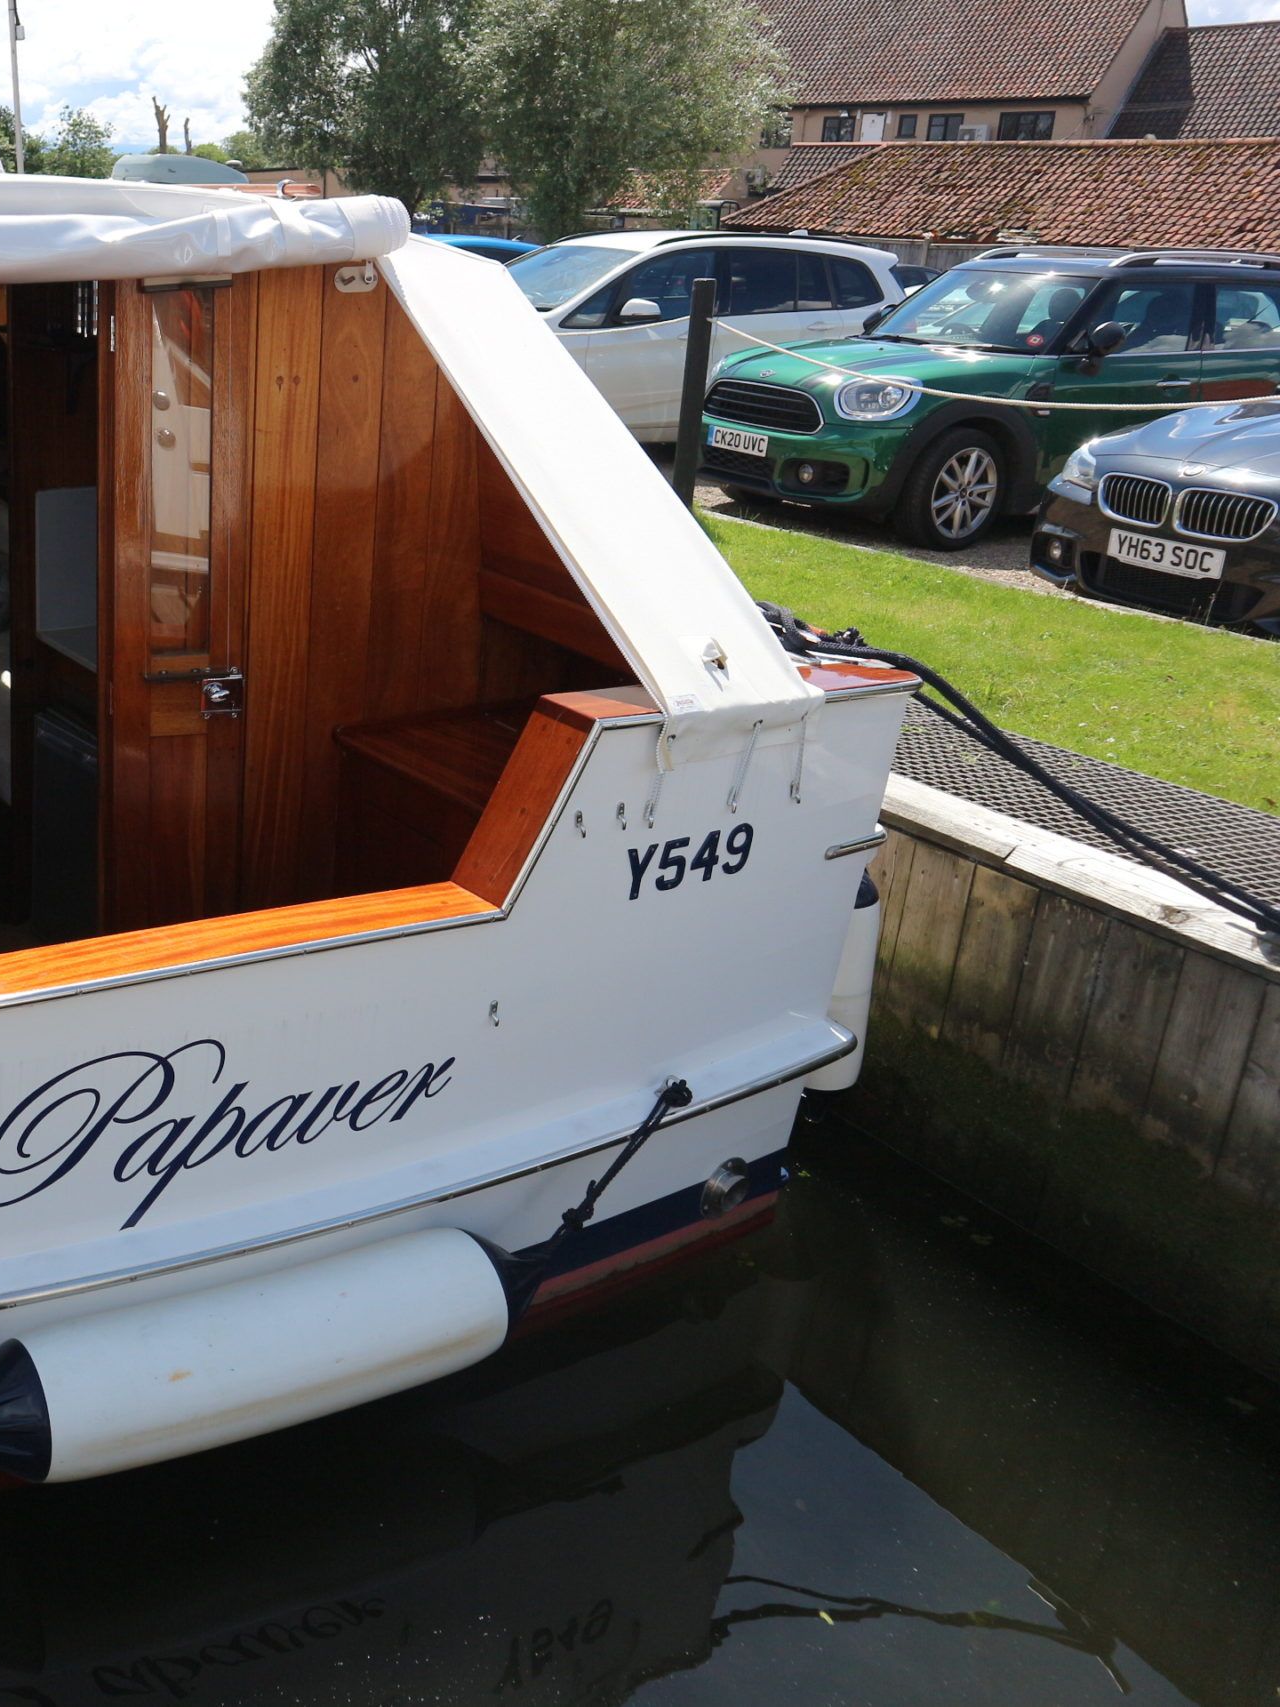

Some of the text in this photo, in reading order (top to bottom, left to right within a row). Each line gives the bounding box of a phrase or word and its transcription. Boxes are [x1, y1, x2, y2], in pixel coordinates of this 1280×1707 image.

[714, 429, 766, 453] CK20 UVC
[1118, 533, 1214, 573] YH63 SOC
[627, 822, 754, 901] Y549
